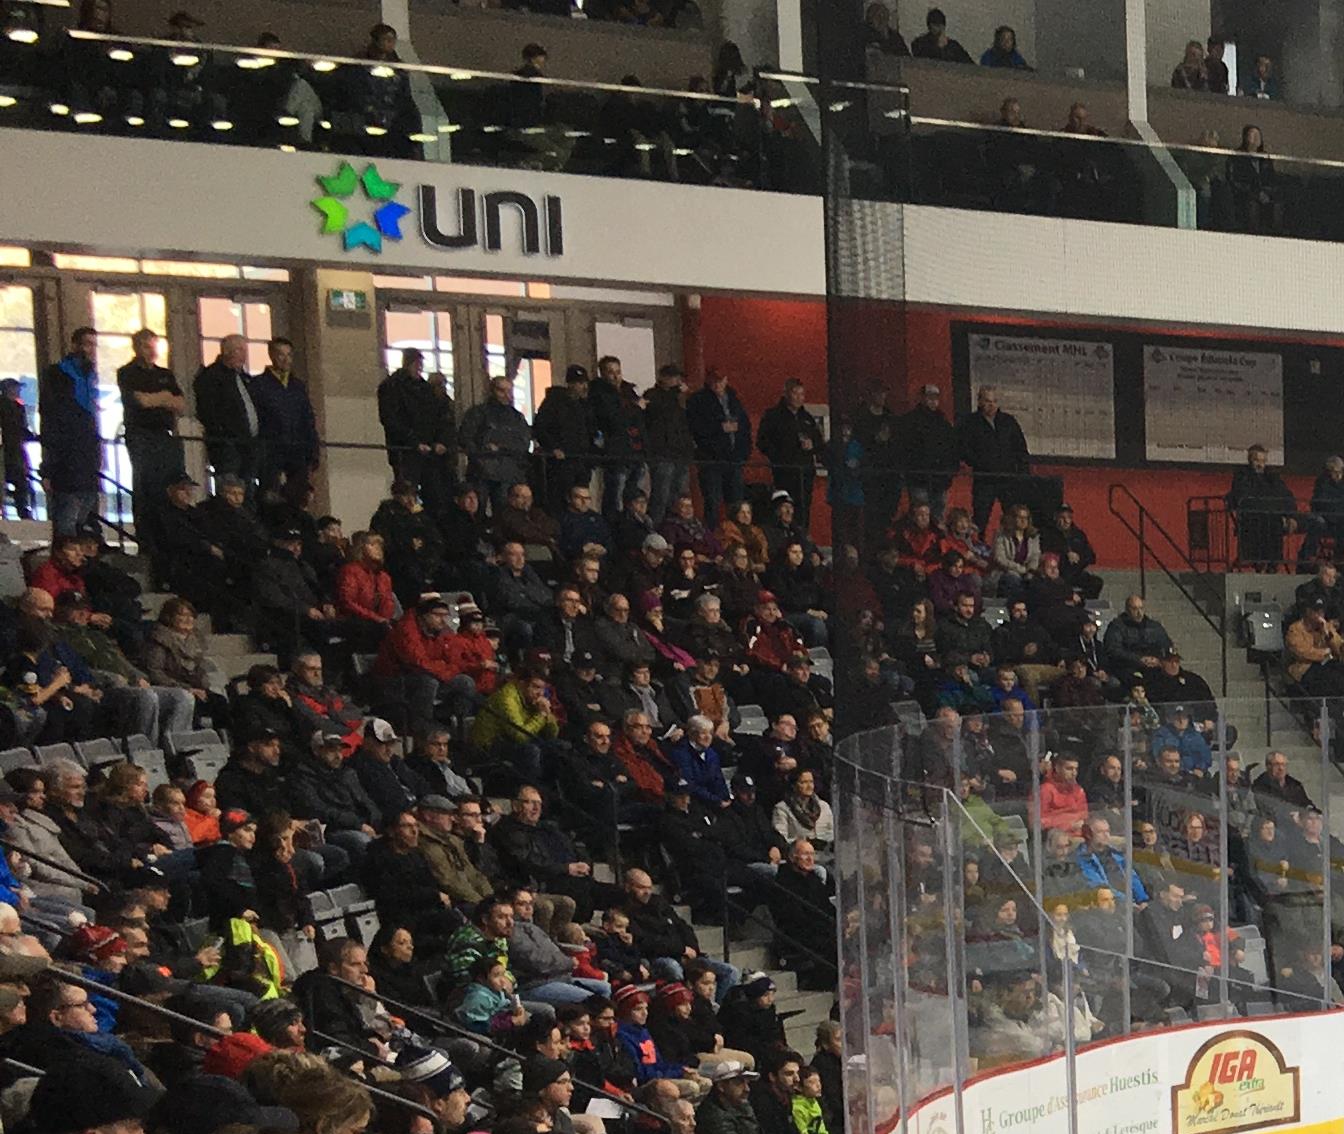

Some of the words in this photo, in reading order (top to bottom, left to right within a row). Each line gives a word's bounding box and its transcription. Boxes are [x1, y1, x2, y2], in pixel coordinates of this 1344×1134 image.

[1208, 1049, 1257, 1085] IGA
[1238, 1077, 1265, 1092] extra
[999, 1102, 1046, 1129] Groupe
[1108, 1068, 1159, 1095] Huestis
